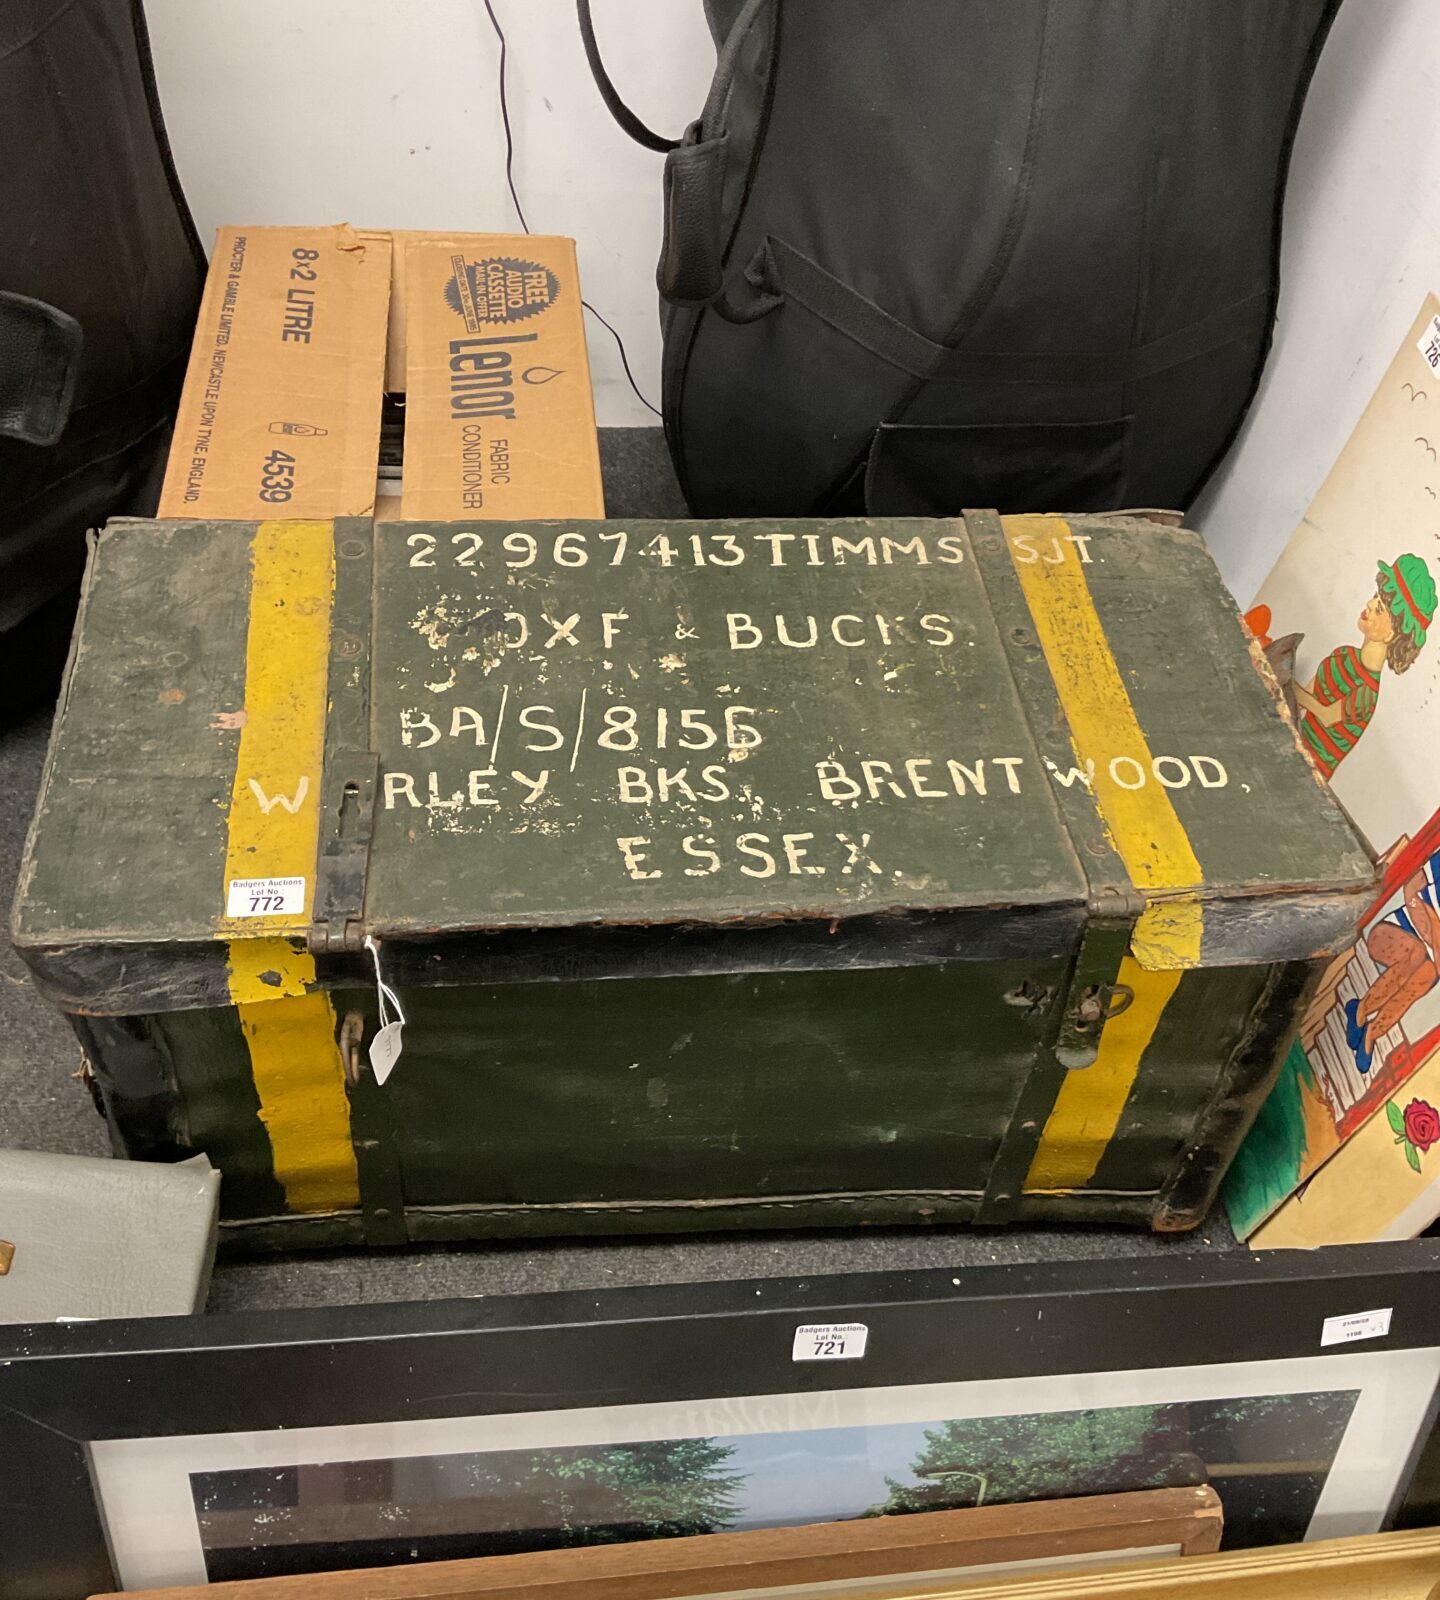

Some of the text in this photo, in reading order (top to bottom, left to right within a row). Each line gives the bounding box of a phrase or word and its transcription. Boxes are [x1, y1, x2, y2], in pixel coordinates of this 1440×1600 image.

[229, 236, 247, 272] PROCTER
[222, 281, 239, 312] GAMBLE
[486, 263, 507, 318] CASSETTE
[505, 270, 524, 308] AUDIO
[524, 271, 550, 304] FREE
[282, 289, 315, 344] LITRE
[464, 305, 475, 318] JUNE
[476, 296, 489, 318] OFFER
[205, 349, 226, 399] NEWCASTLE
[449, 333, 538, 419] Lenor
[200, 401, 217, 427] UPON
[258, 449, 296, 503] 4539
[462, 424, 483, 509] CONDITIONER
[490, 439, 511, 484] FABRIC
[674, 622, 700, 640] &
[249, 896, 284, 912] 772
[813, 1341, 846, 1355] 721
